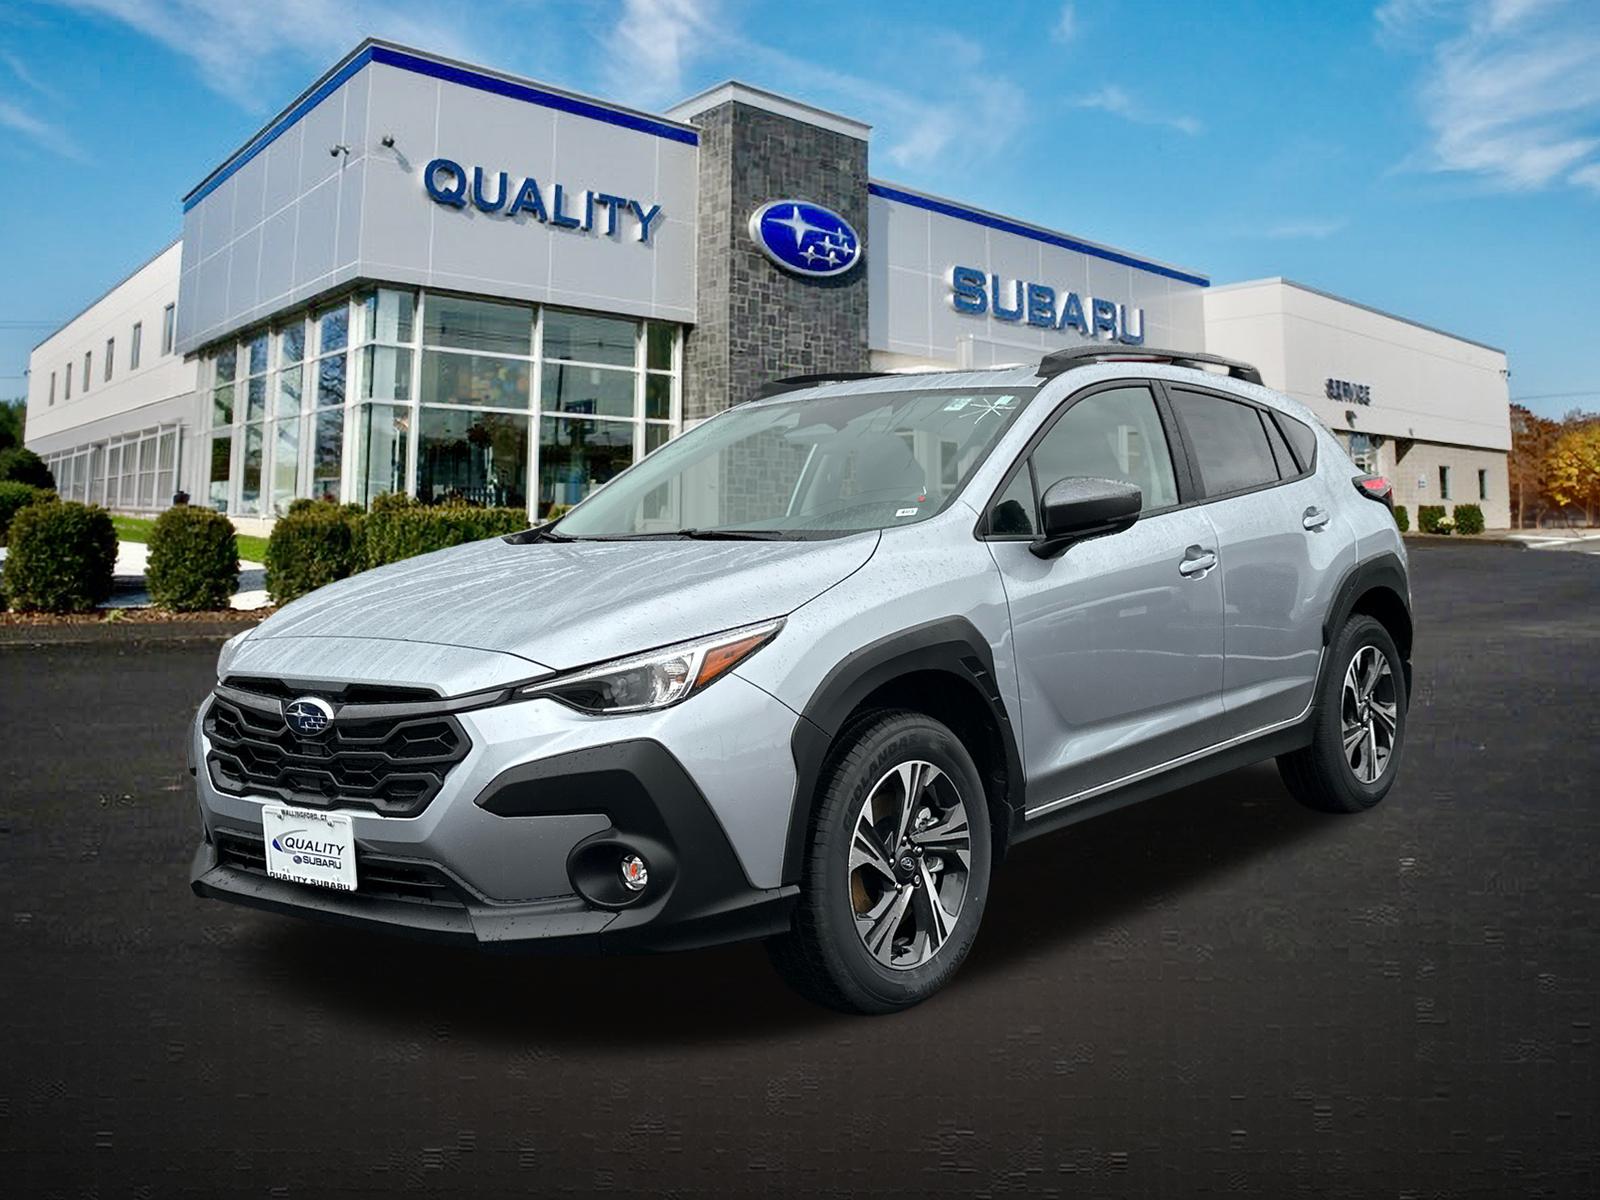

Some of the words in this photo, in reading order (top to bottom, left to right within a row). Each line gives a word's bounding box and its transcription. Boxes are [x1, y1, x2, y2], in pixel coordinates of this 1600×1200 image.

[424, 158, 662, 243] QUALITY
[949, 265, 1145, 346] SUBARU
[1324, 378, 1370, 407] SERVICE
[285, 837, 345, 856] QUALITY
[302, 856, 342, 869] SUBARU
